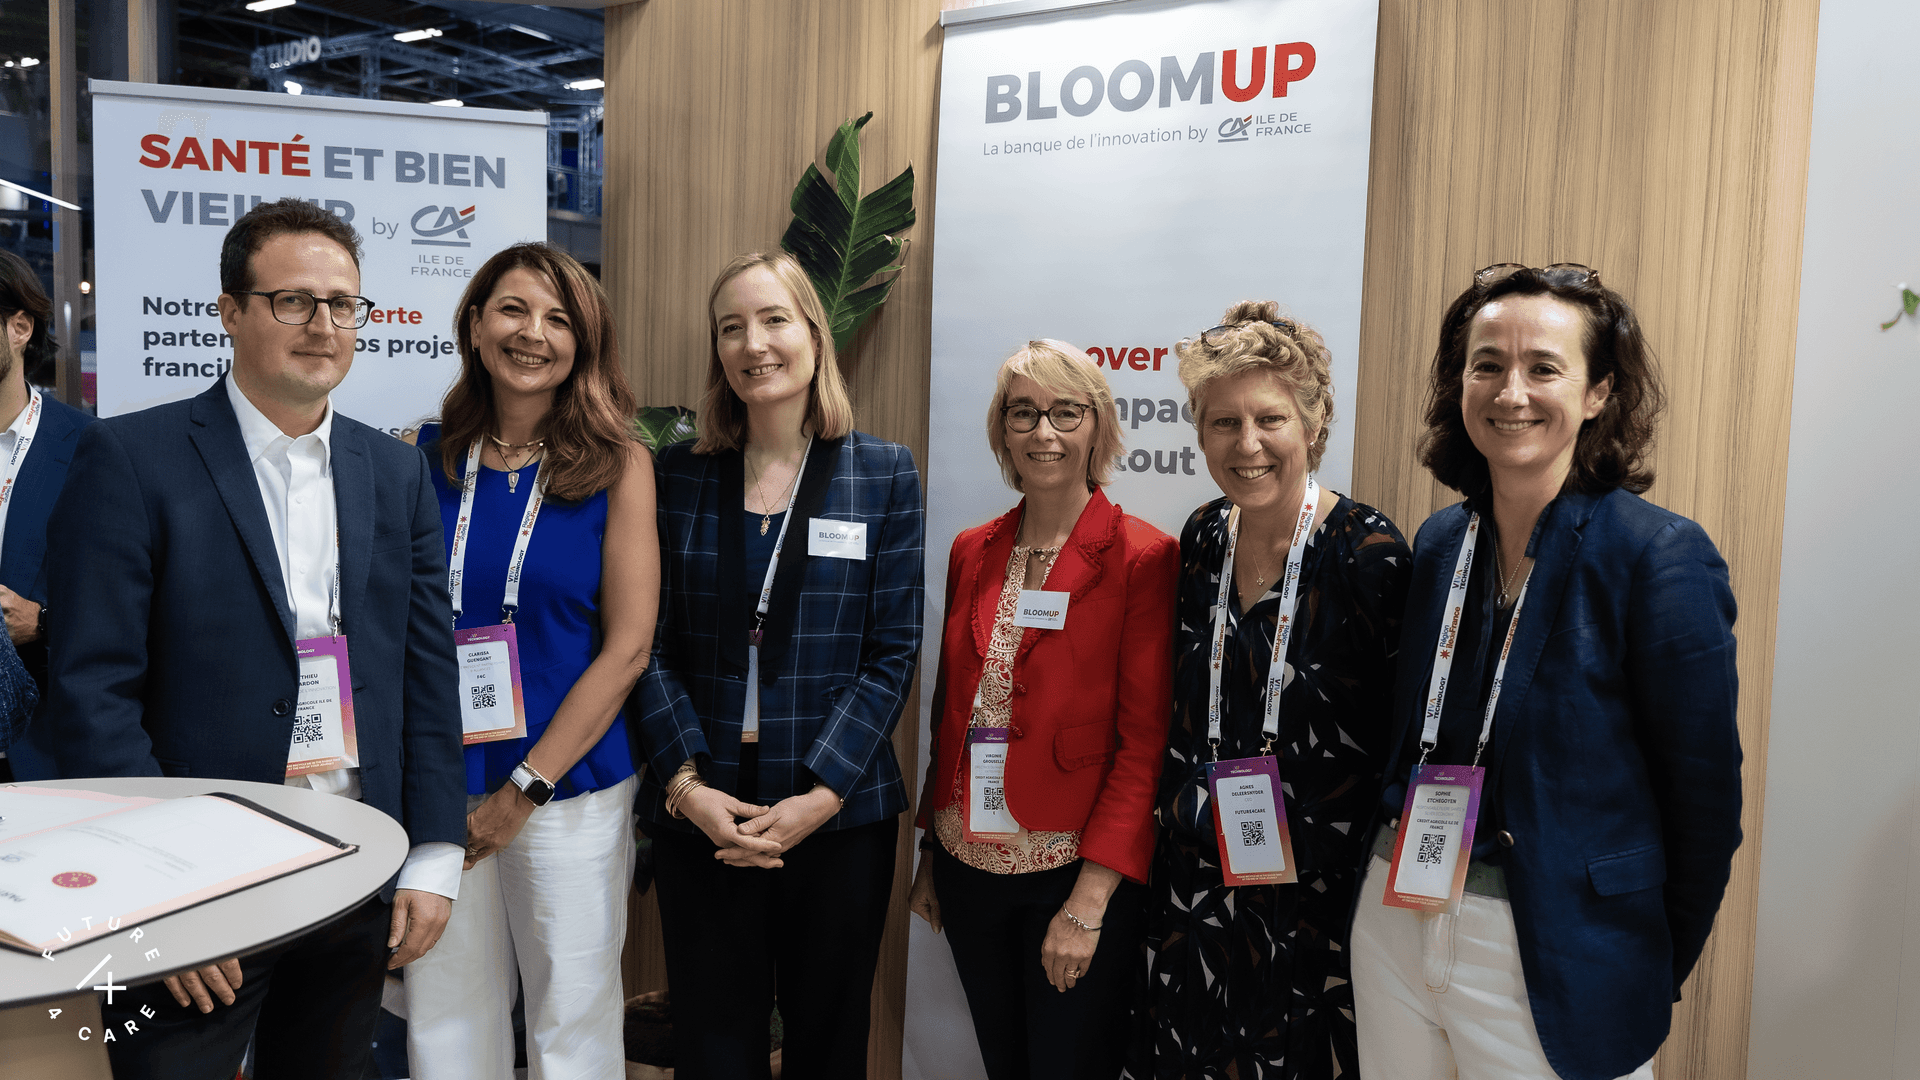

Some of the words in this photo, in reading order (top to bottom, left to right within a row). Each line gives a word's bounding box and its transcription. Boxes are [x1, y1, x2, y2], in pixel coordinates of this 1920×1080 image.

[985, 41, 1316, 124] BLOOMUP
[1255, 123, 1312, 137] FRANCE
[1256, 113, 1276, 125] ILE
[1279, 111, 1298, 123] DE
[983, 143, 999, 156] La
[1004, 140, 1062, 156] banque
[1066, 135, 1085, 150] de
[1188, 125, 1208, 143] by
[139, 133, 311, 177] SANTÉ
[323, 145, 385, 181] ET
[395, 150, 506, 189] BIEN
[372, 216, 399, 240] by
[411, 266, 472, 279] FRANCE
[418, 254, 440, 265] ILE
[444, 255, 464, 266] DE
[143, 296, 220, 317] Notre
[370, 307, 423, 325] erte
[143, 329, 235, 351] parten
[354, 338, 381, 353] os
[388, 334, 455, 359] proje
[143, 356, 232, 378] francil
[1085, 346, 1169, 372] over
[818, 532, 860, 541] BLOOMUP
[513, 549, 524, 584] TECHNOLOGY
[1283, 561, 1294, 600] TECHNOLOGY
[1459, 548, 1472, 590] TECHNOLOGY
[1023, 608, 1060, 618] BLOOMUP
[1266, 677, 1274, 716] TECHNOLOGY
[1434, 676, 1446, 720] TECHNOLOGY
